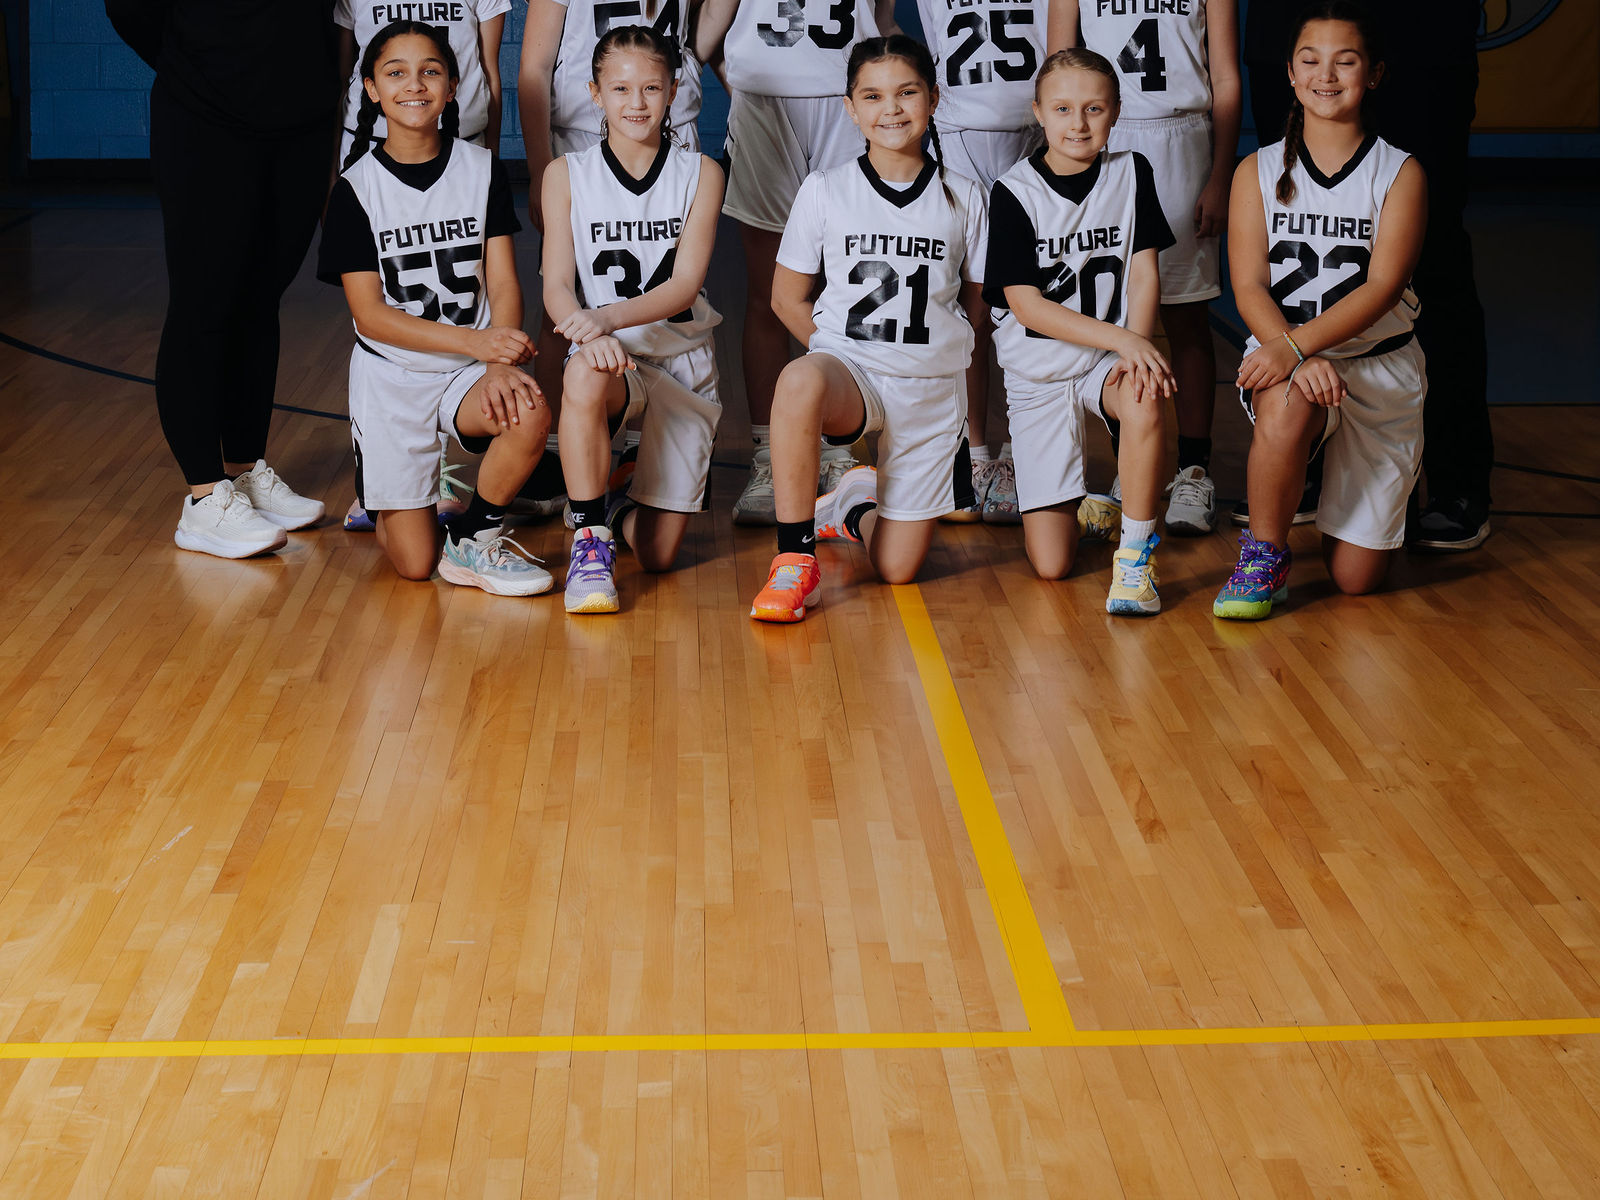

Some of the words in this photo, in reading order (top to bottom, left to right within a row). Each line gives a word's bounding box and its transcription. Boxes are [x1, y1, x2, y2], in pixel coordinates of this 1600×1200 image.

[372, 2, 464, 25] FUTURE
[946, 9, 1038, 87] 25
[1116, 18, 1167, 92] 4
[379, 216, 481, 253] FUTURE
[590, 217, 682, 243] FUTURE
[845, 234, 946, 261] FUTURE
[1272, 212, 1373, 240] FUTURE
[380, 243, 483, 326] 55
[845, 260, 930, 344] 21
[1268, 239, 1372, 324] 22
